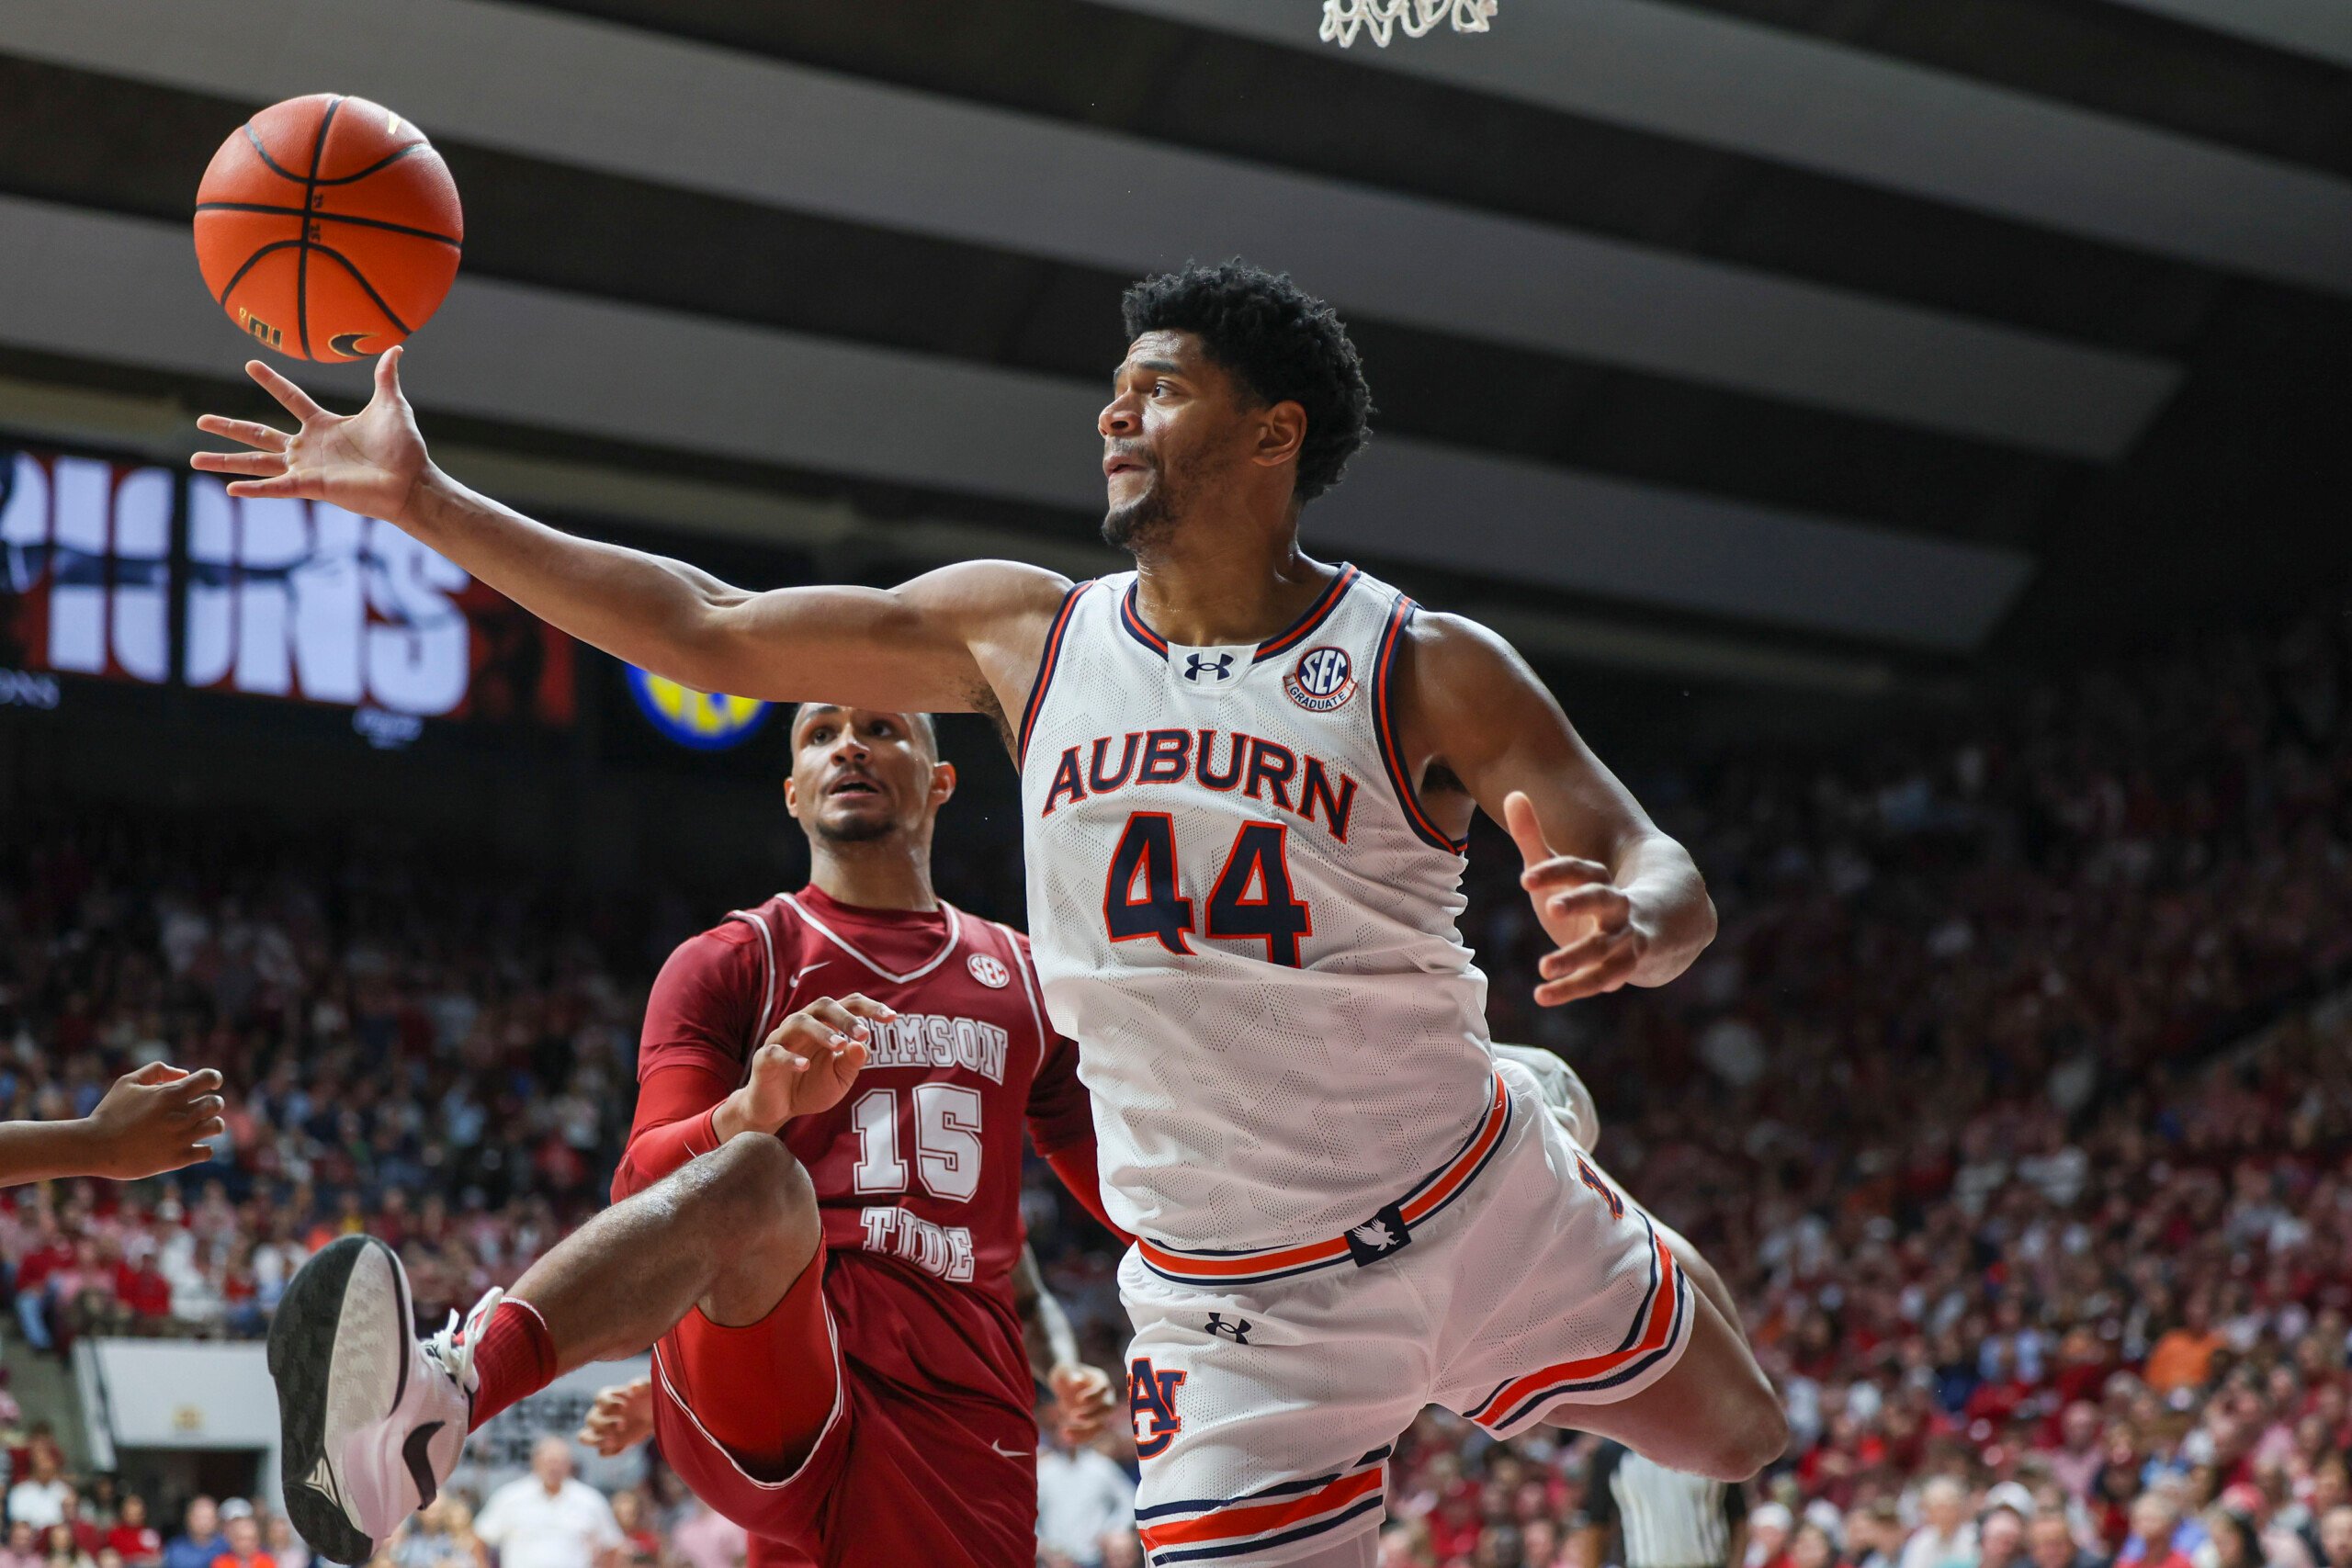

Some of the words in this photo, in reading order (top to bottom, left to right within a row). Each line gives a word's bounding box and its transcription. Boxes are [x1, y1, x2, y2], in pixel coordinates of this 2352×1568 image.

[1289, 686, 1346, 709] GRADUATE
[1301, 649, 1347, 694] SEC
[1042, 728, 1357, 843] AUBURN
[1102, 811, 1312, 969] 44
[969, 955, 1007, 986] SEC
[840, 1013, 1008, 1086] IMSON
[852, 1082, 982, 1203] 15
[860, 1206, 974, 1282] TIDE
